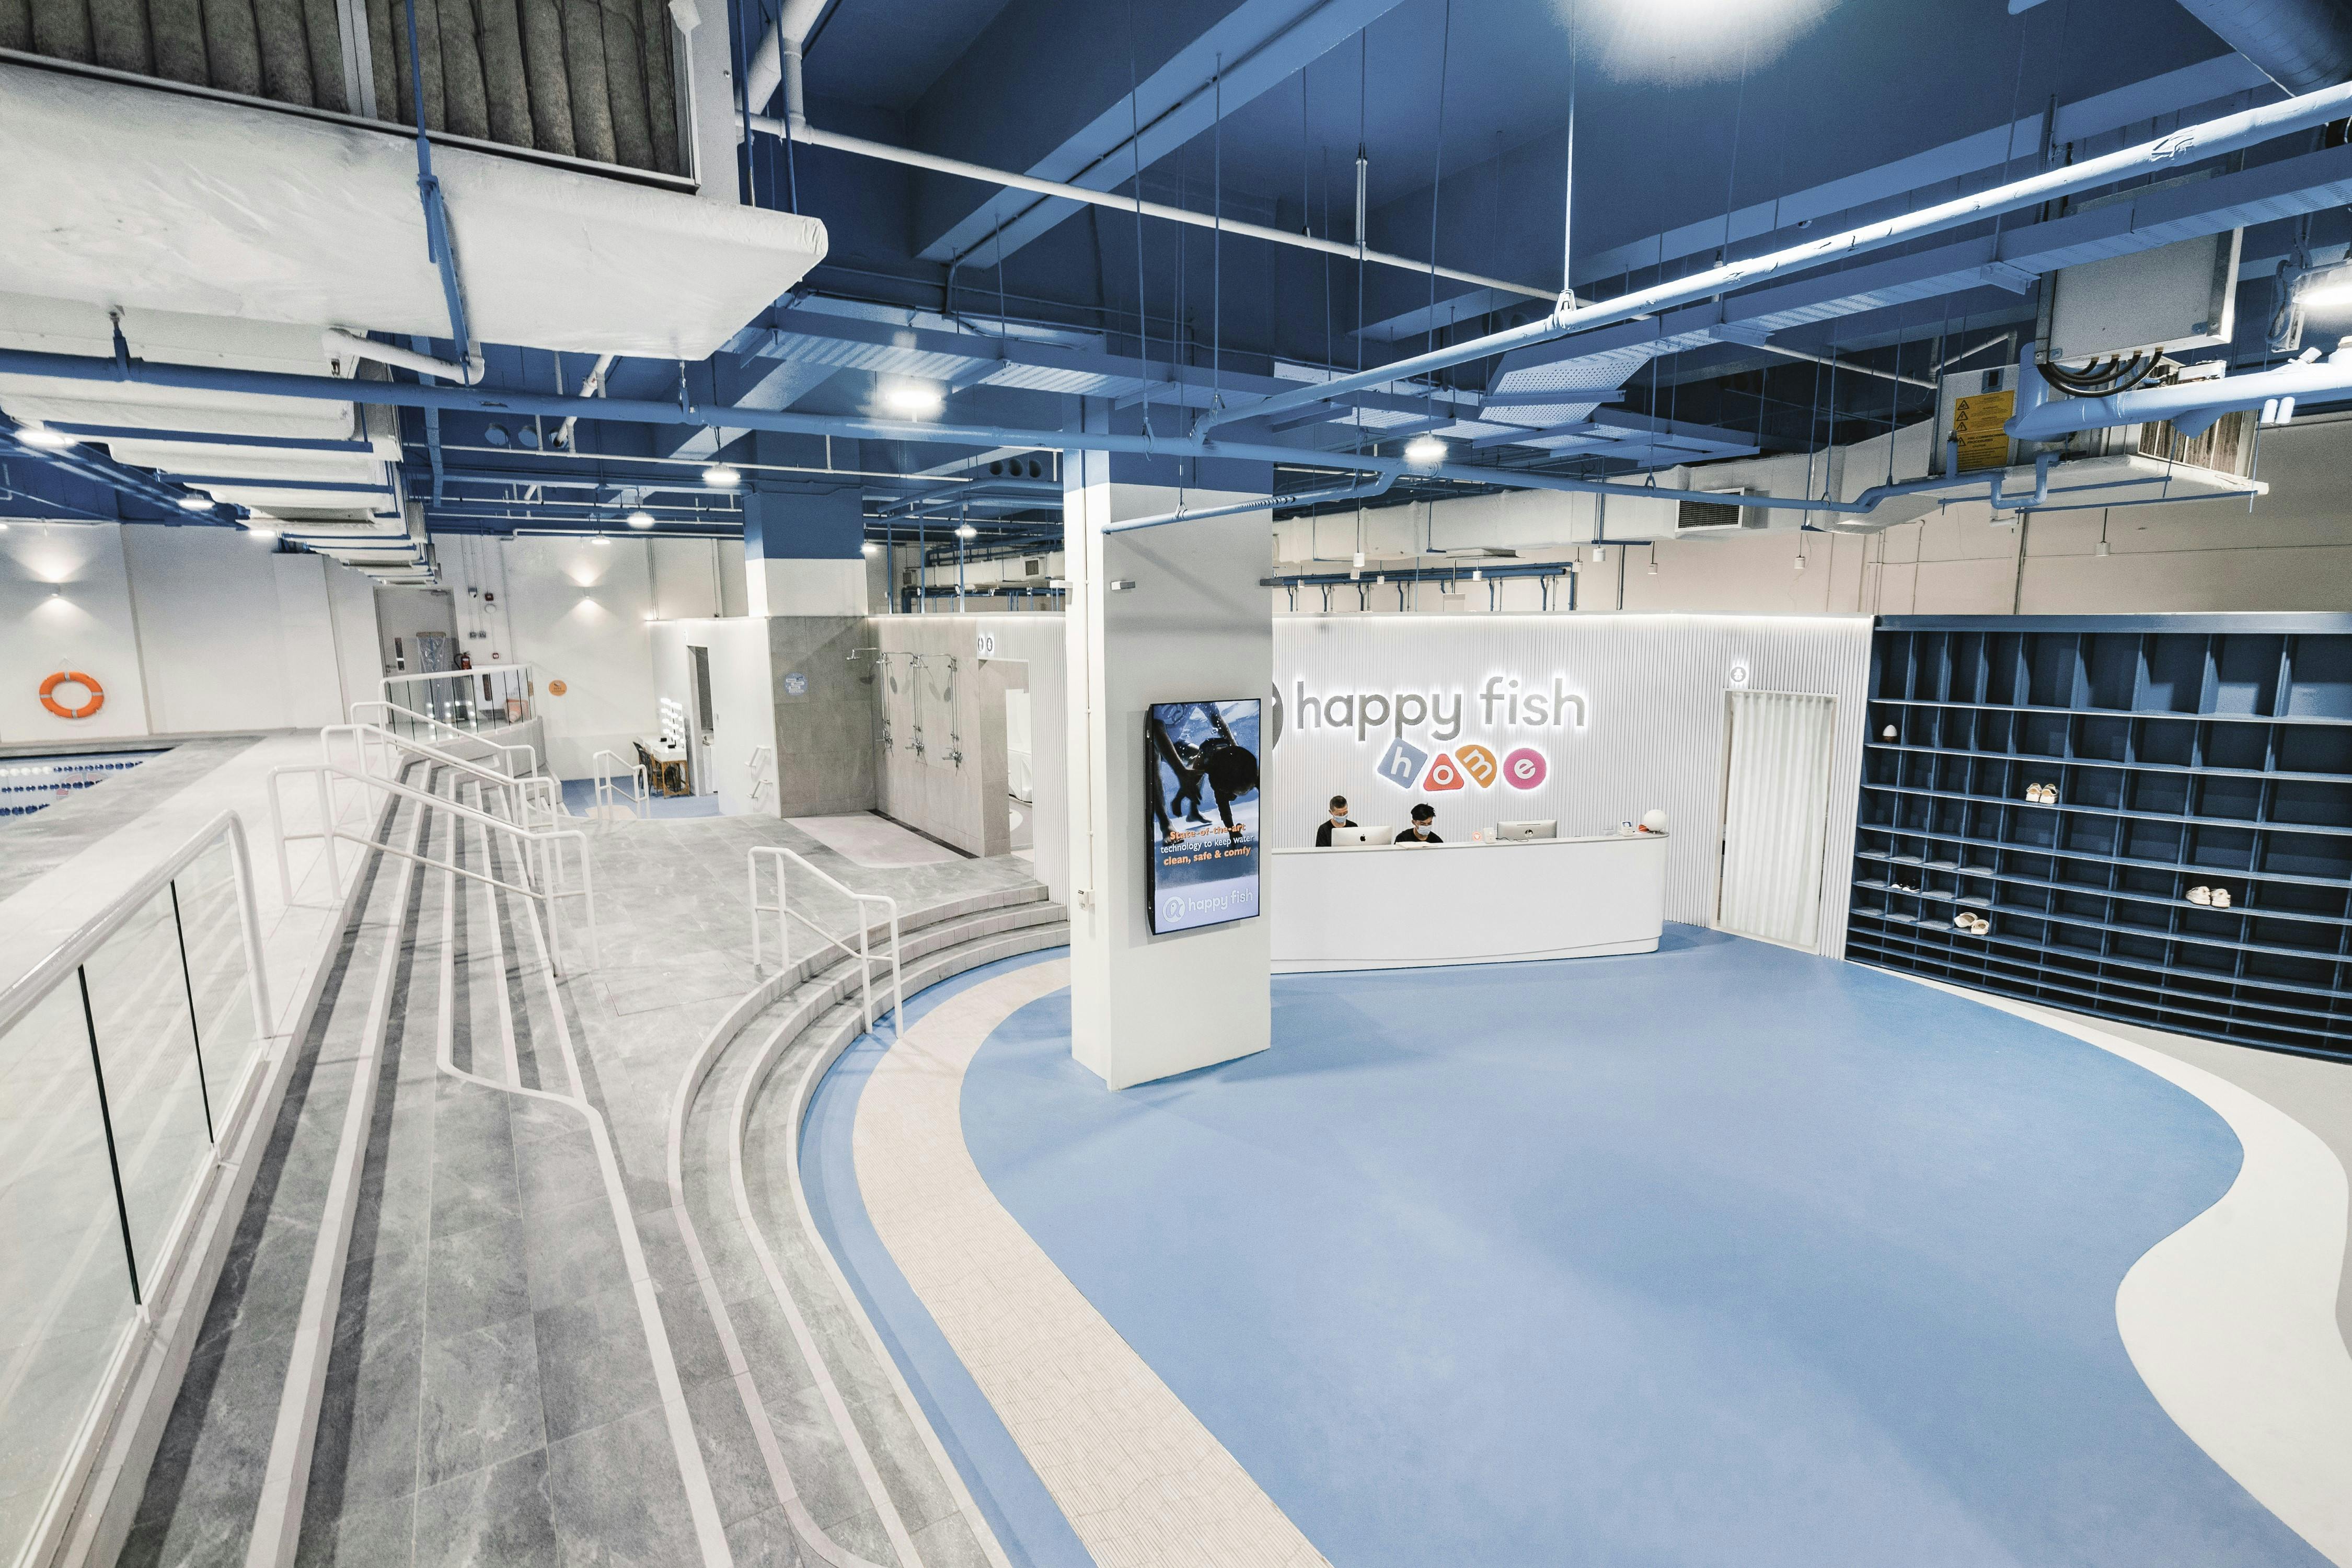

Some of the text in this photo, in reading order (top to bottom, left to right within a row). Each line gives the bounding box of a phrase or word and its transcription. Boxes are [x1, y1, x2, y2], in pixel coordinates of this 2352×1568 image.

[1297, 676, 1585, 742] happy fish
[1390, 746, 1536, 785] home
[1170, 823, 1246, 840] State-of-the-art
[1160, 842, 1202, 854] technology
[1214, 838, 1231, 847] keep
[1163, 846, 1251, 866] clean, safe & comfy
[1188, 889, 1253, 913] happy fish
